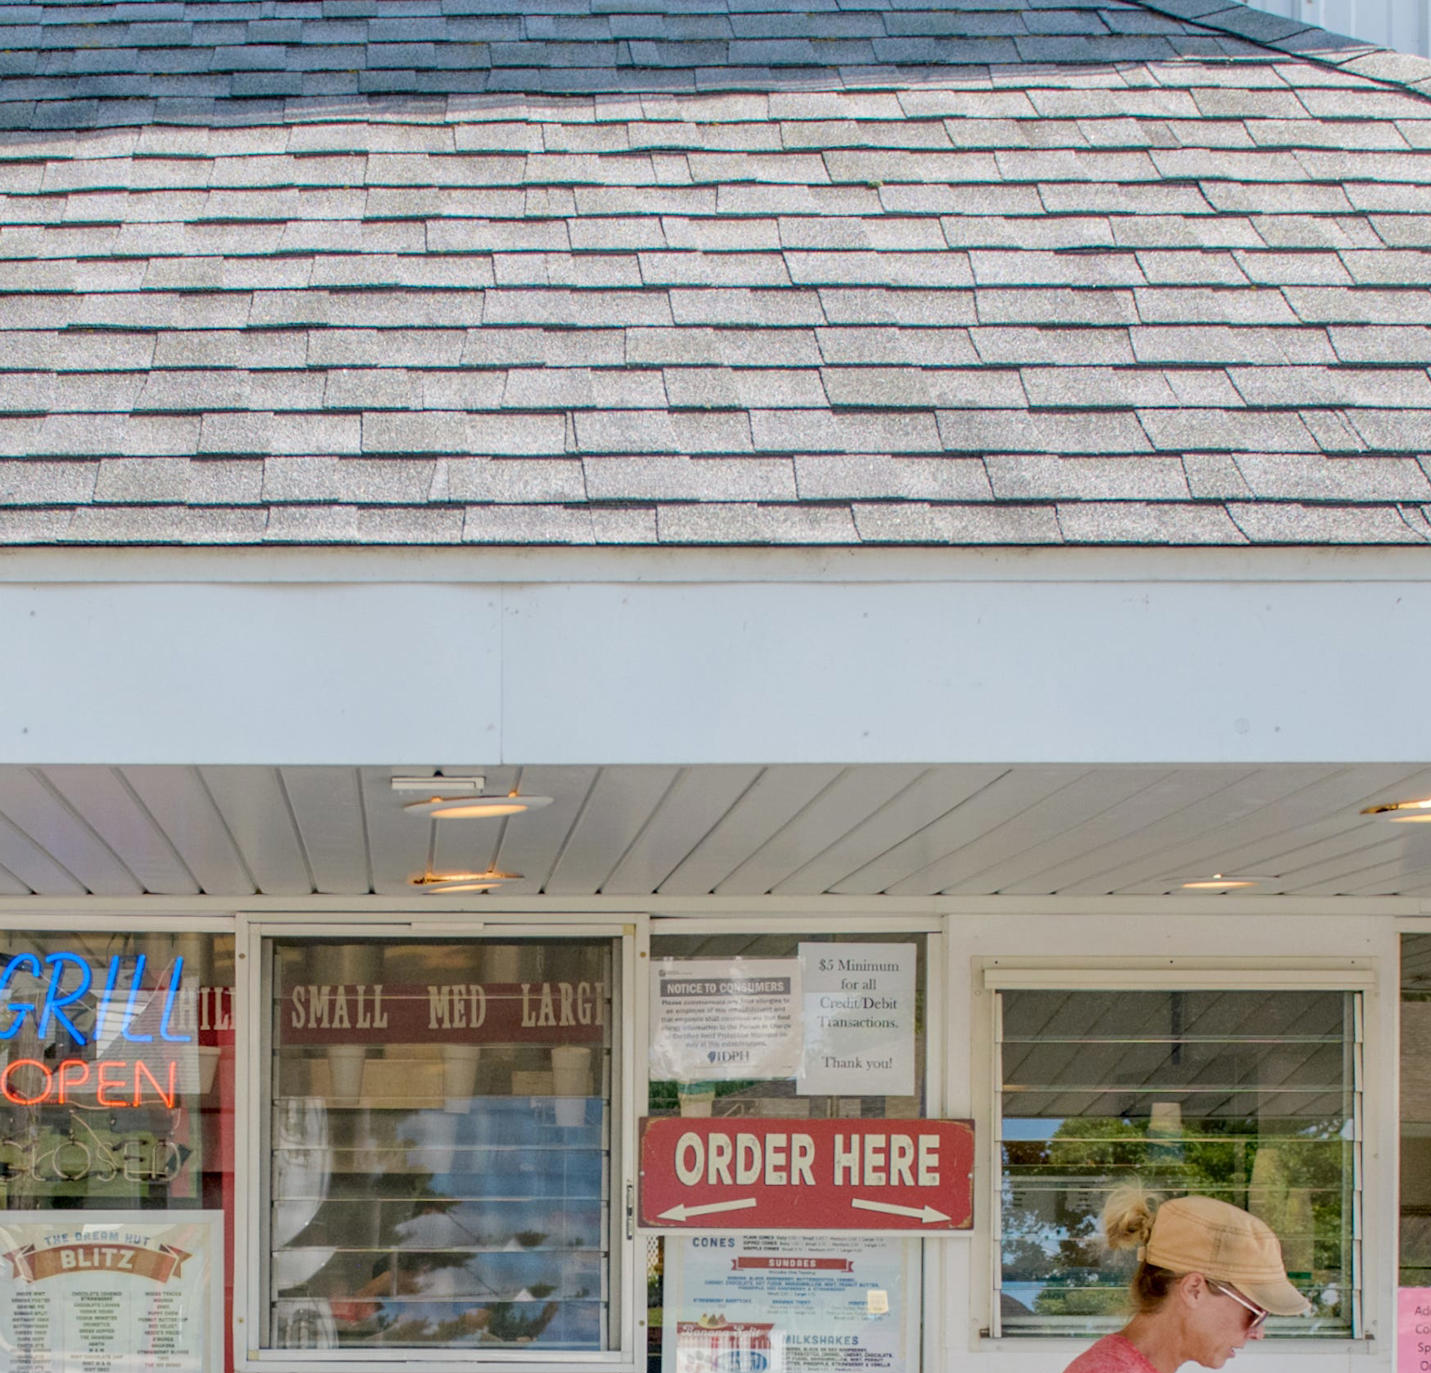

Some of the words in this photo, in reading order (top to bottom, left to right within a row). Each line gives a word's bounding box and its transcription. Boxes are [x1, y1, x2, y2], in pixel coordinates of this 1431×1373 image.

[819, 958, 834, 971] $5
[838, 959, 899, 972] Minimum
[667, 983, 703, 994] NOTICE
[705, 983, 717, 993] TO
[719, 981, 785, 994] CONSUMERS
[841, 978, 859, 990] for
[862, 978, 877, 990] all
[291, 985, 388, 1029] SMALL
[427, 985, 486, 1029] MED
[817, 1016, 899, 1028] Transactions.
[821, 1056, 863, 1069] Thank
[866, 1057, 893, 1071] you!
[0, 1058, 177, 1109] OPEN
[674, 1131, 816, 1187] ORDER
[833, 1133, 941, 1187] HERE
[43, 1233, 70, 1246] THE
[74, 1230, 119, 1242] DREAM
[124, 1234, 151, 1247] HUT
[692, 1237, 736, 1248] CONES
[59, 1247, 138, 1269] BLITZ
[768, 1258, 817, 1268] SUNDAES
